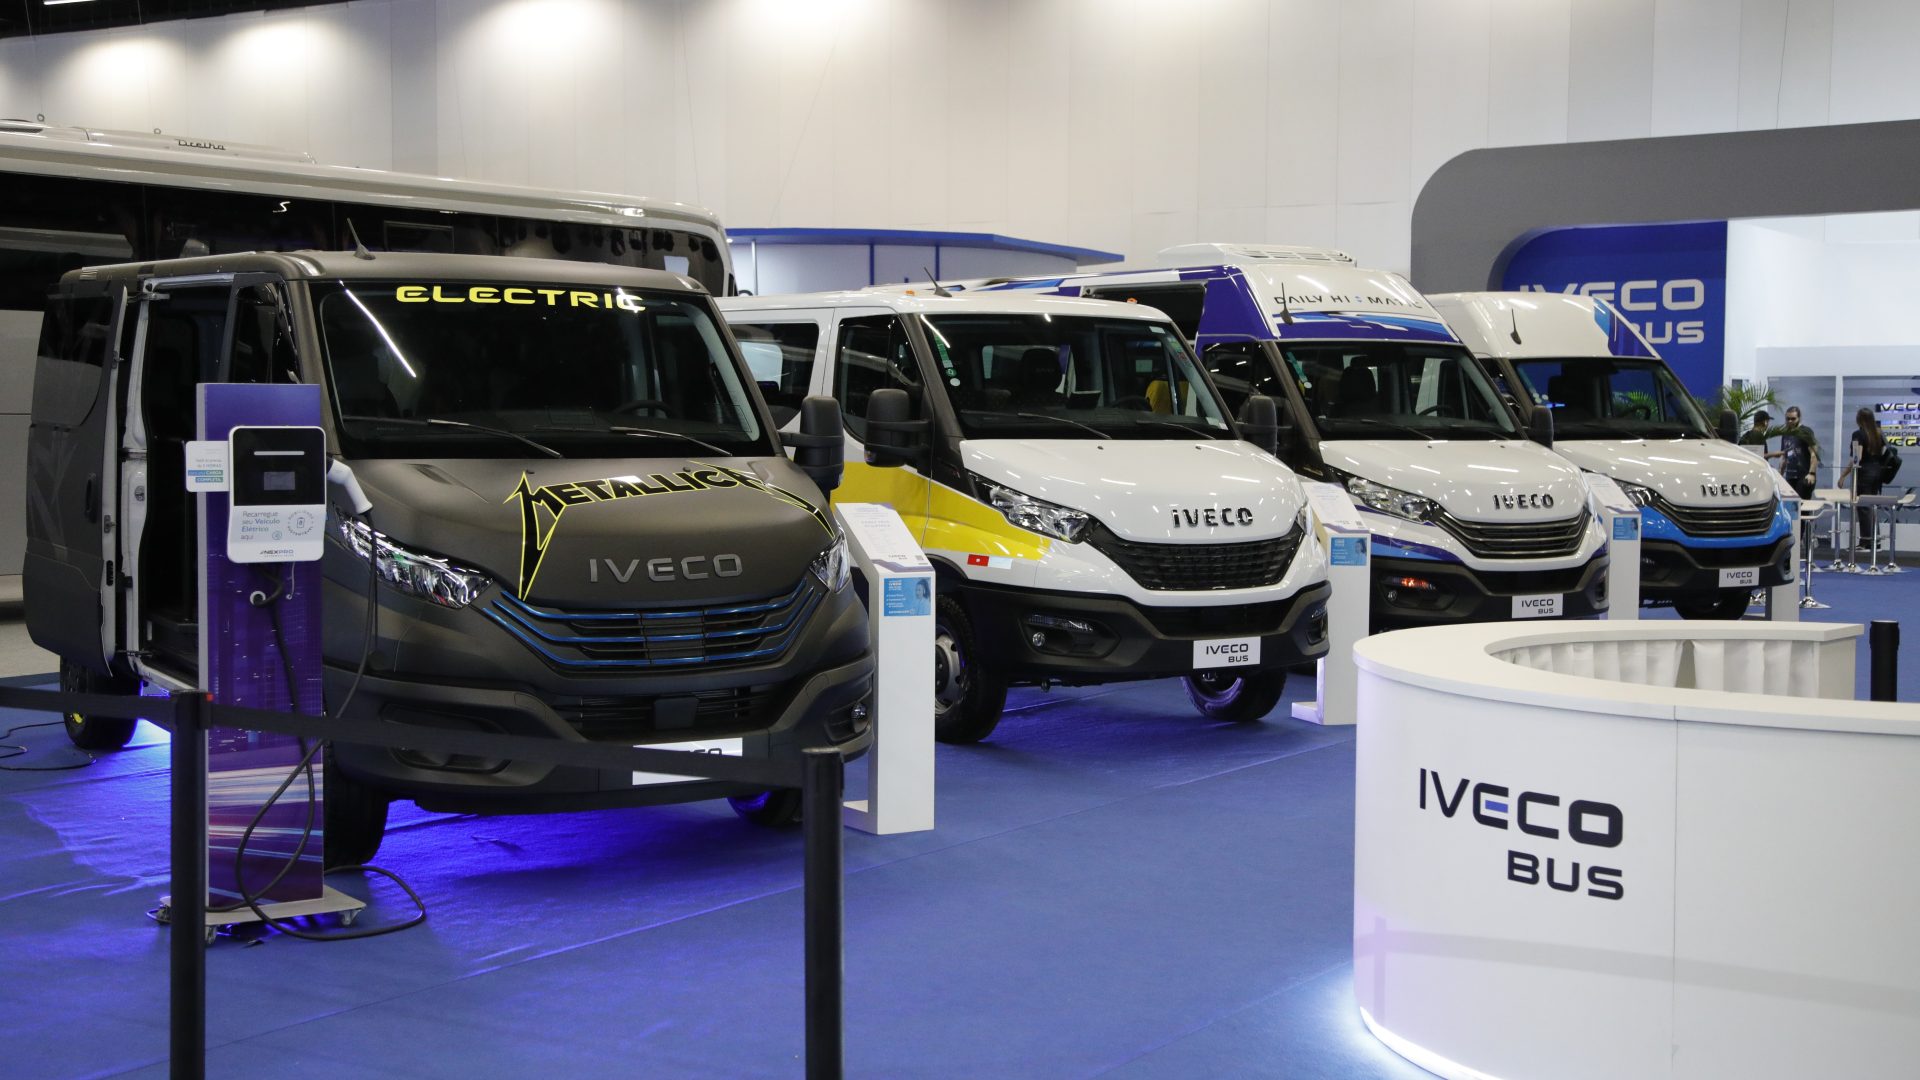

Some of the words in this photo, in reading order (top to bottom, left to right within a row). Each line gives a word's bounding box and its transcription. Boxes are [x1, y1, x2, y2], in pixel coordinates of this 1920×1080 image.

[396, 285, 646, 312] ELECTRIC
[1274, 295, 1323, 305] DAILY
[1631, 320, 1705, 345] US
[1701, 484, 1750, 497] IVECO
[1493, 493, 1554, 510] IVECO
[1172, 507, 1254, 528] IVECO
[590, 553, 743, 583] IVECO
[1726, 571, 1753, 579] IVECO
[1521, 598, 1554, 608] IVECO
[1537, 607, 1554, 615] BUS
[1206, 643, 1249, 655] IVECO
[1228, 655, 1249, 663] BUS
[1419, 767, 1624, 849] IVECO
[1507, 849, 1625, 901] BUS
